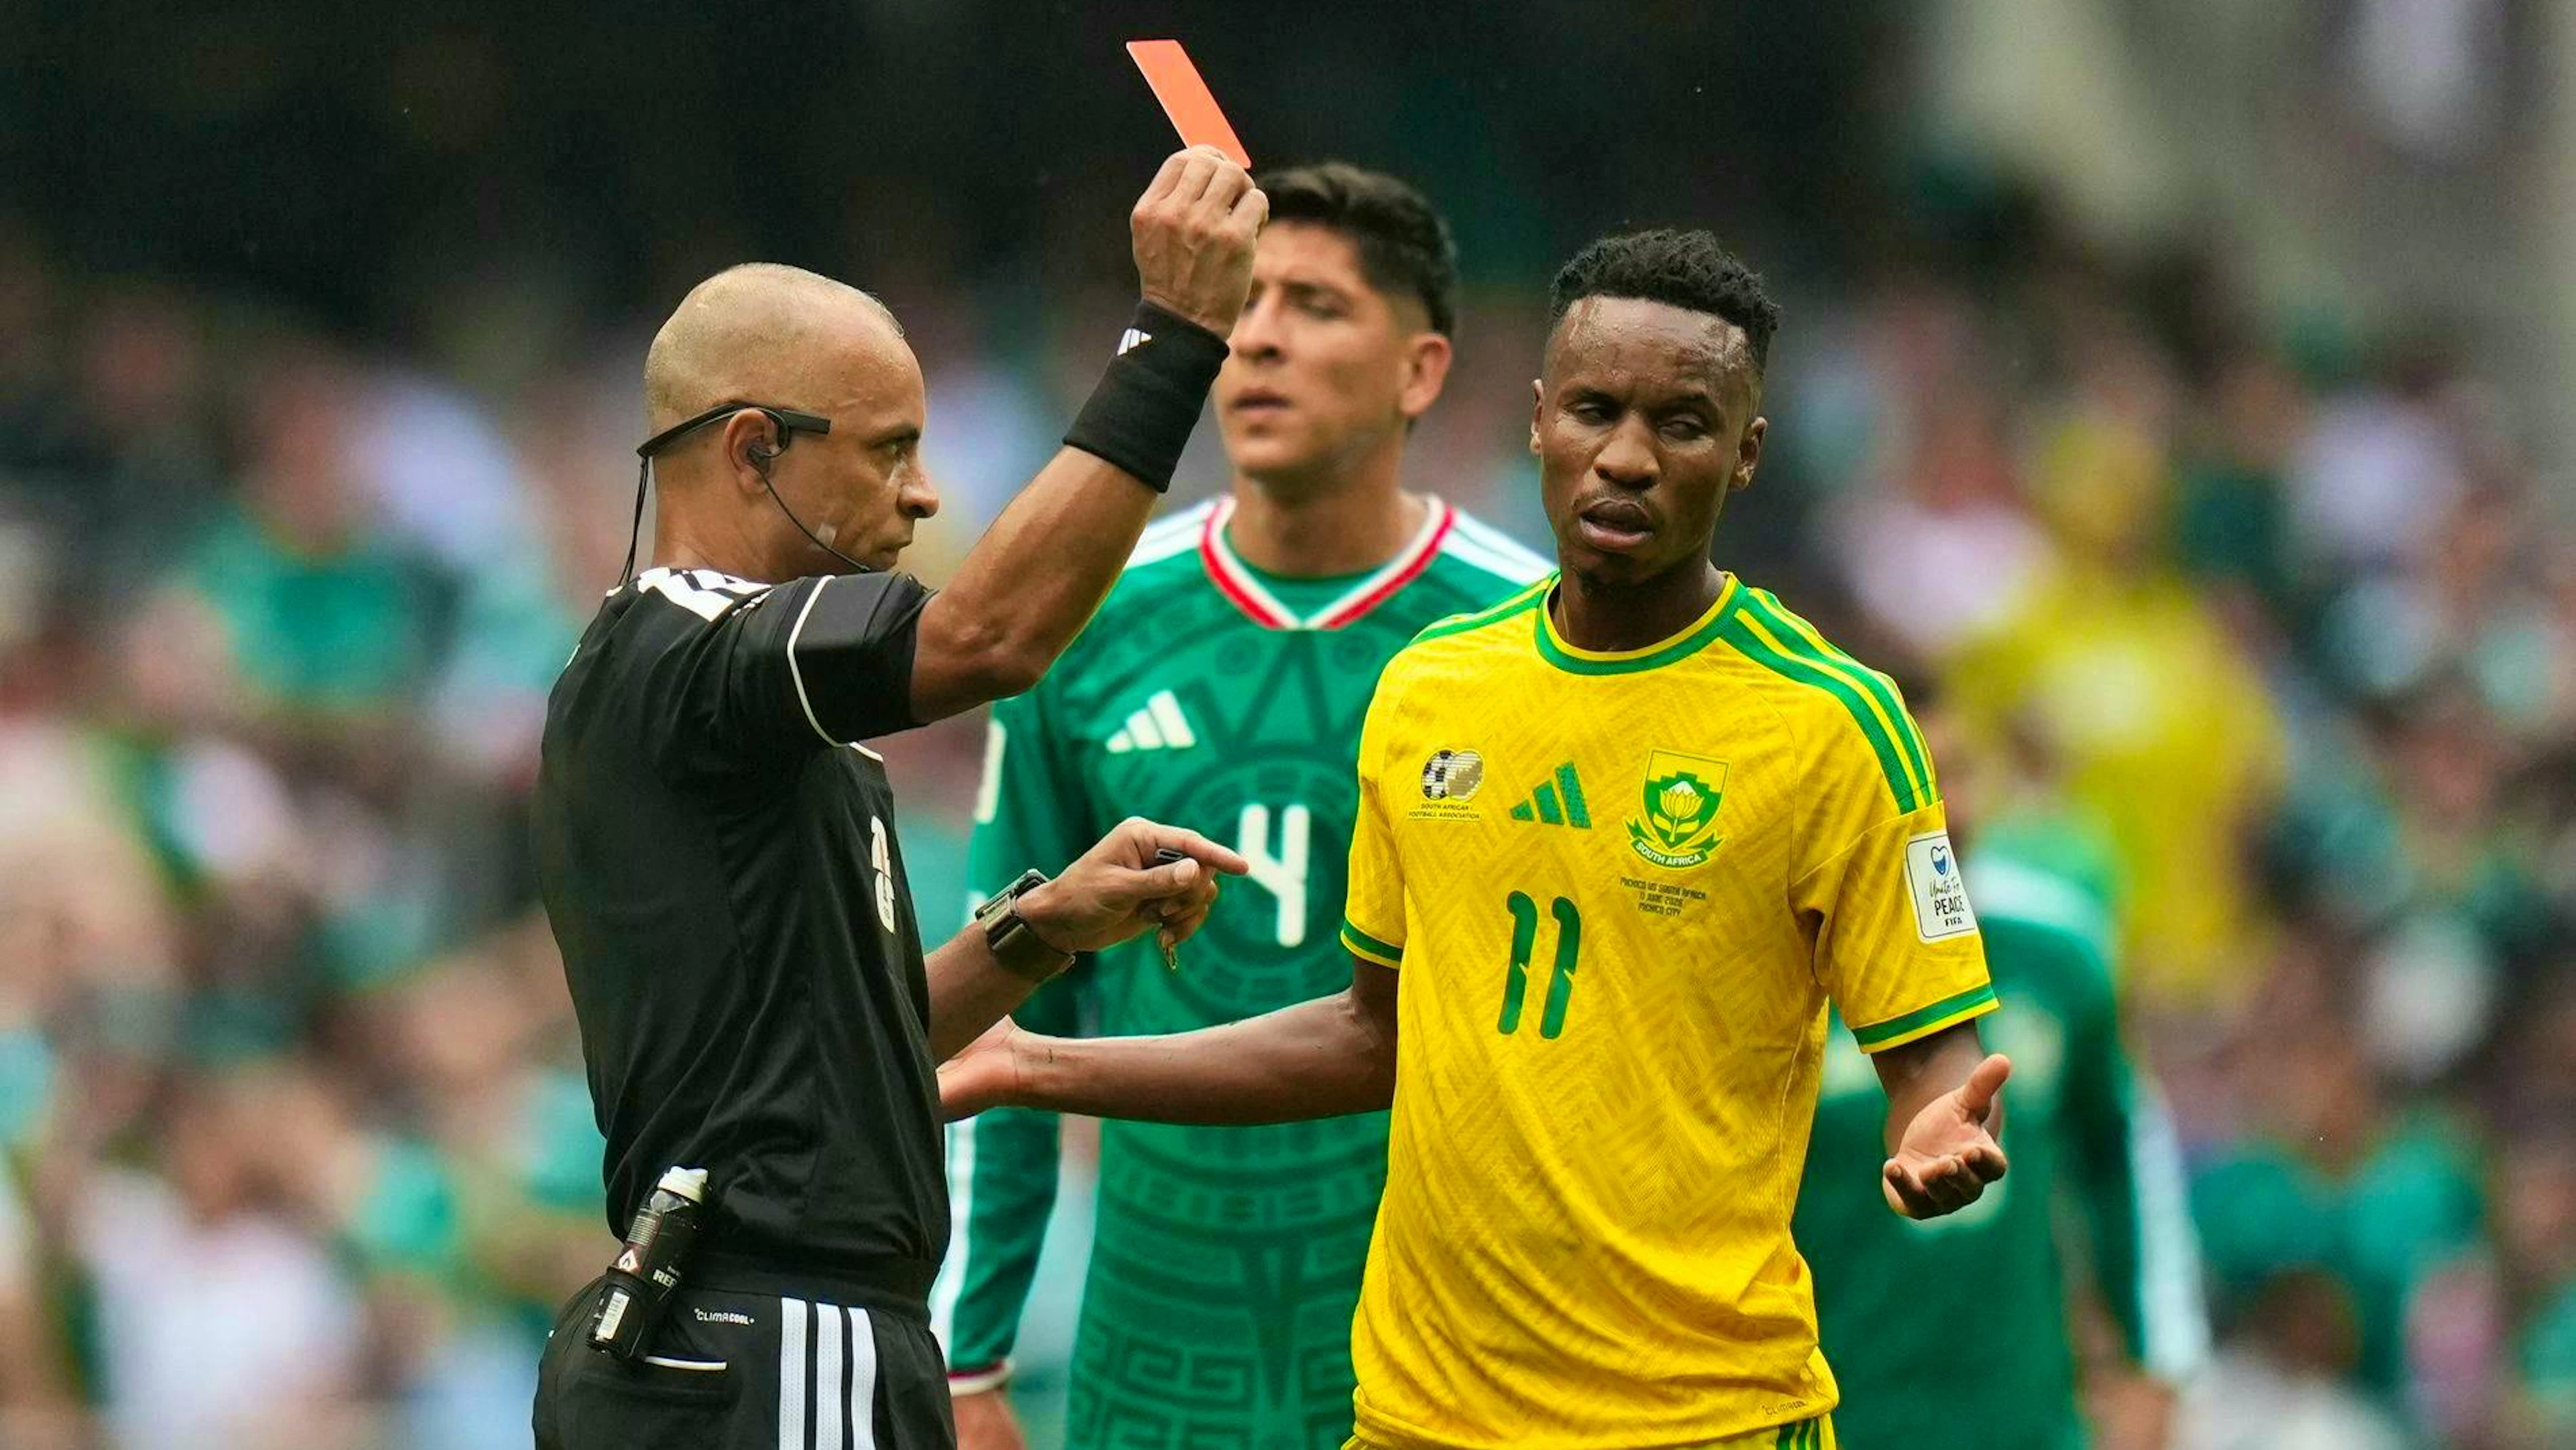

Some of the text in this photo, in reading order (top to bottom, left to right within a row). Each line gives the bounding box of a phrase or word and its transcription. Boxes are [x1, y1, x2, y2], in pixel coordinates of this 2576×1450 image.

[1635, 841, 1702, 866] SOUTH AFRICA
[1236, 803, 1310, 947] 4
[1934, 894, 1966, 917] PEACE
[1945, 917, 1964, 927] FIFA
[1497, 890, 1582, 1039] 11
[695, 1311, 751, 1325] CLIMACOOL
